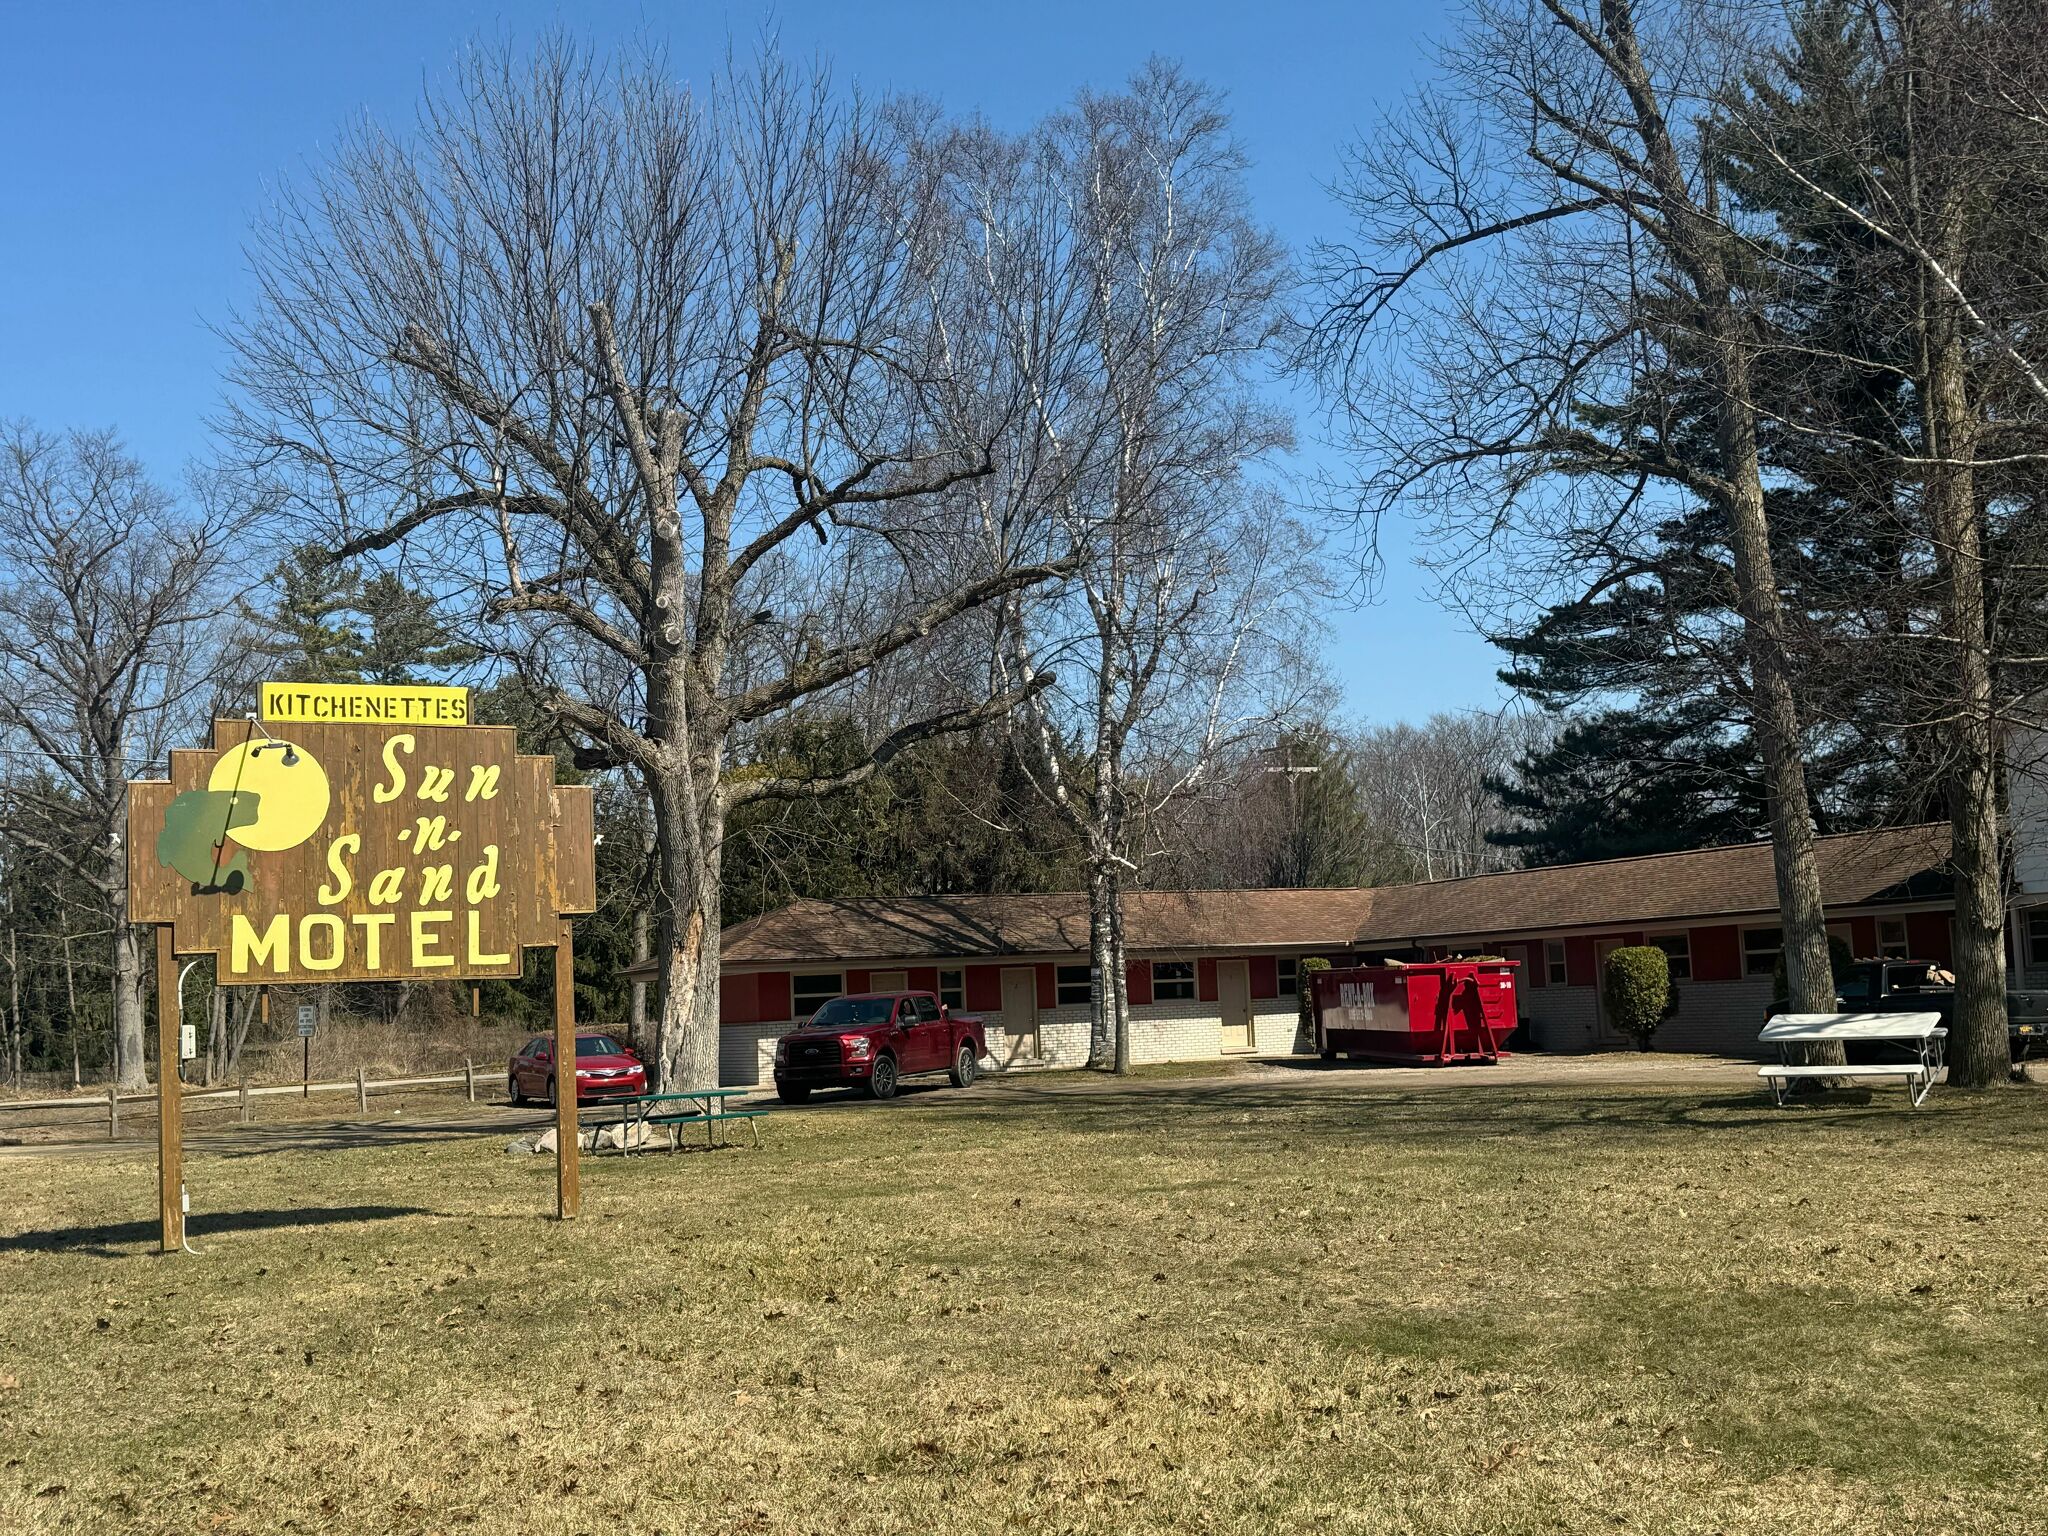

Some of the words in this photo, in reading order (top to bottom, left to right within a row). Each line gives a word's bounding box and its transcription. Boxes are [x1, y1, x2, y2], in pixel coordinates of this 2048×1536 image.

[270, 693, 466, 719] KITCHENETTES
[373, 733, 501, 803] Sun
[317, 833, 501, 906] Sand
[231, 910, 511, 974] MOTEL
